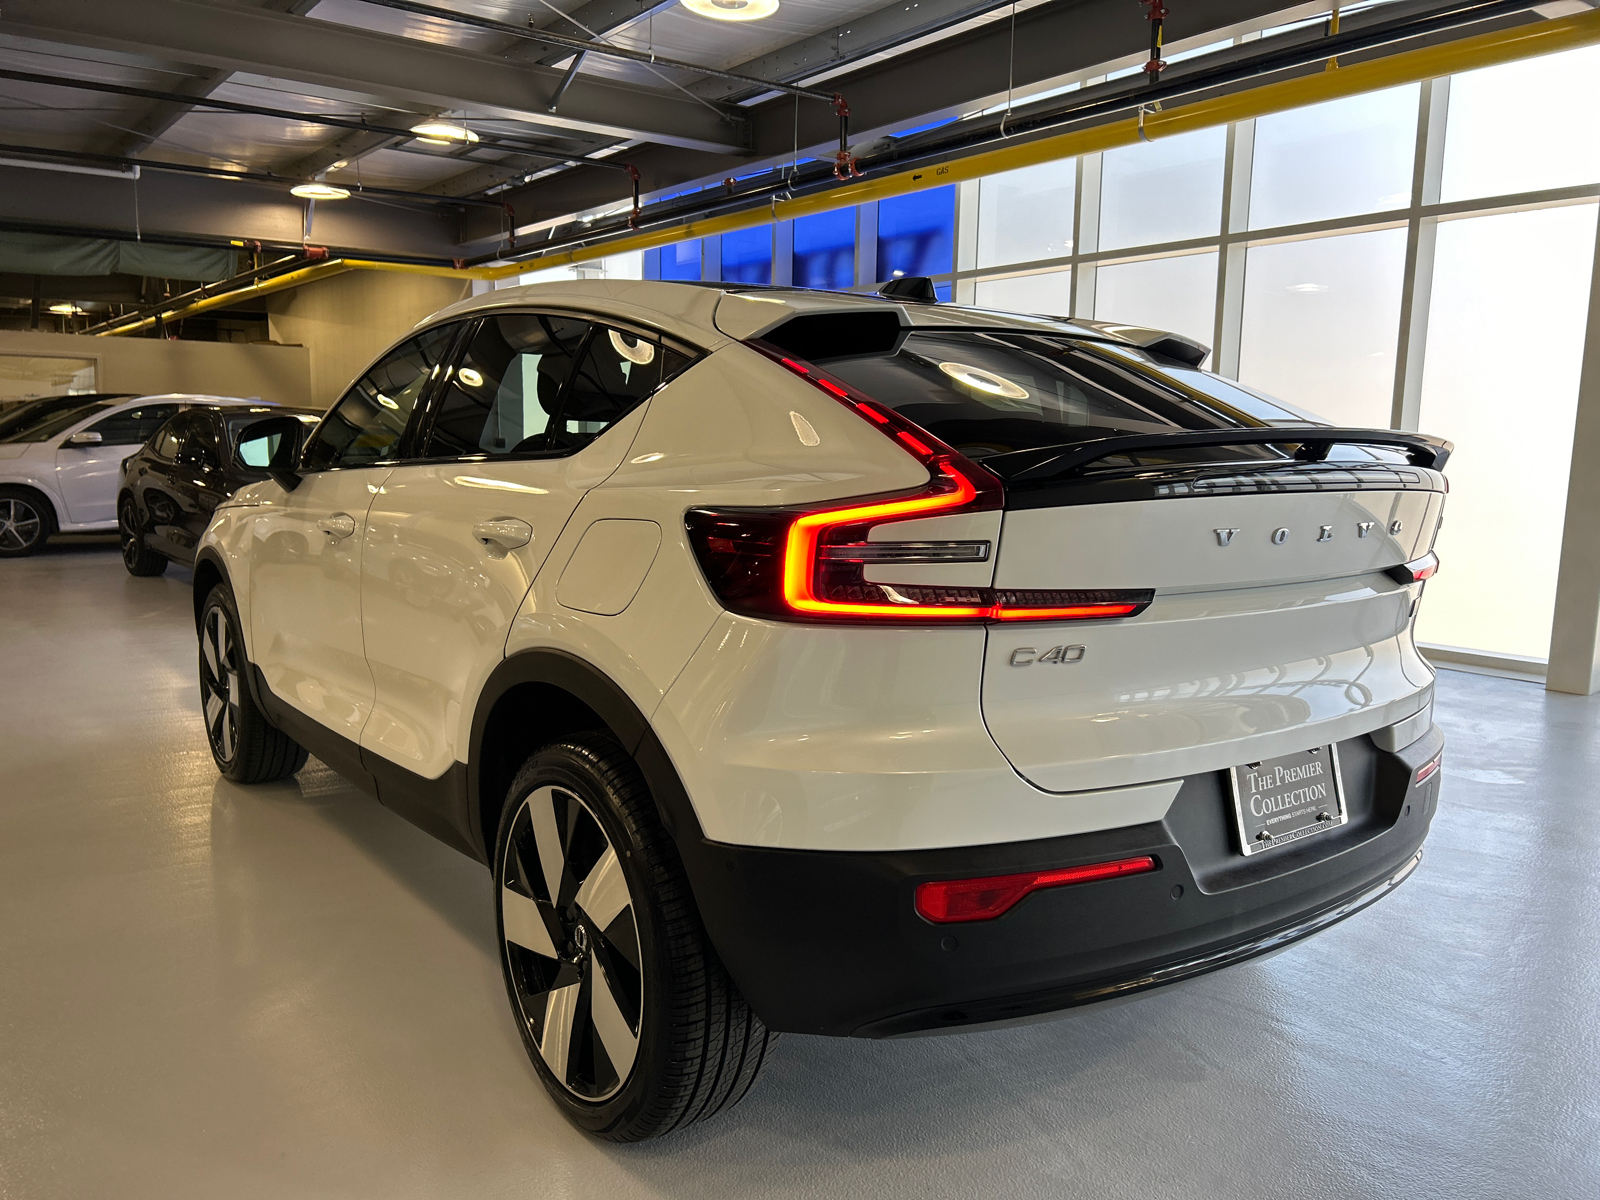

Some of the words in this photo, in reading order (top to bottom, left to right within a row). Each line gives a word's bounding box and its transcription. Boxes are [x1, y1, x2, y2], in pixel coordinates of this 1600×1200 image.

[936, 166, 949, 176] GAS
[1213, 520, 1403, 547] VOLVO
[1009, 643, 1087, 667] C40
[1247, 772, 1274, 794] THE
[1274, 761, 1323, 786] PREMIER
[1250, 783, 1327, 817] COLLECTION
[1266, 814, 1292, 826] EVERYTHING
[1292, 808, 1306, 818] STARTS
